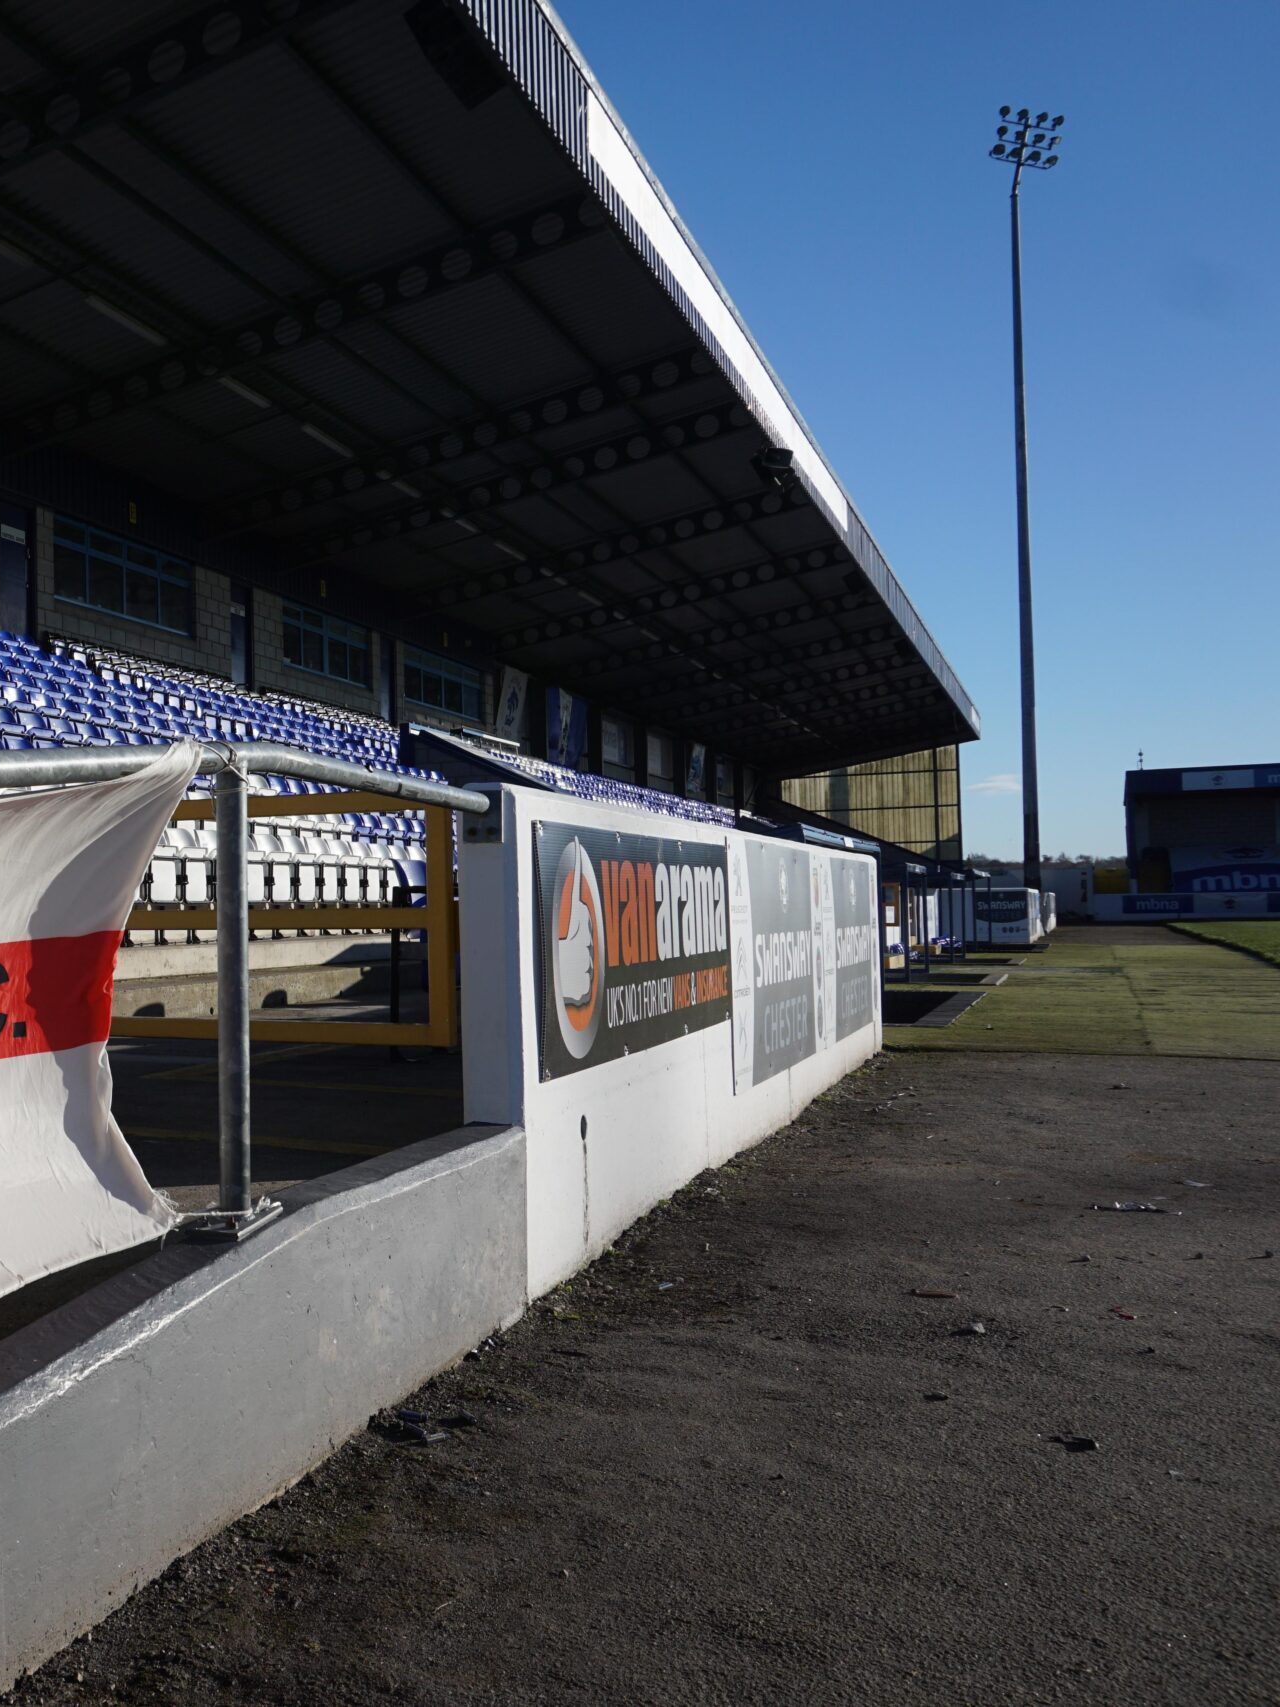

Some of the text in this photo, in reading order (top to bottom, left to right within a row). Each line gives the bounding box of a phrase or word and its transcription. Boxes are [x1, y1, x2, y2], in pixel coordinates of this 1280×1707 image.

[1136, 898, 1179, 911] mbna
[1192, 871, 1280, 892] mbn
[601, 860, 728, 967] vanarama
[756, 930, 811, 988] SWANSWAY
[607, 986, 624, 1028] UK'S
[643, 980, 658, 1019] FOR
[658, 976, 673, 1015] NEW
[673, 973, 690, 1010] VANS
[691, 971, 697, 1006] &
[696, 965, 728, 1004] INSURANCE
[765, 994, 808, 1055] CHESTER
